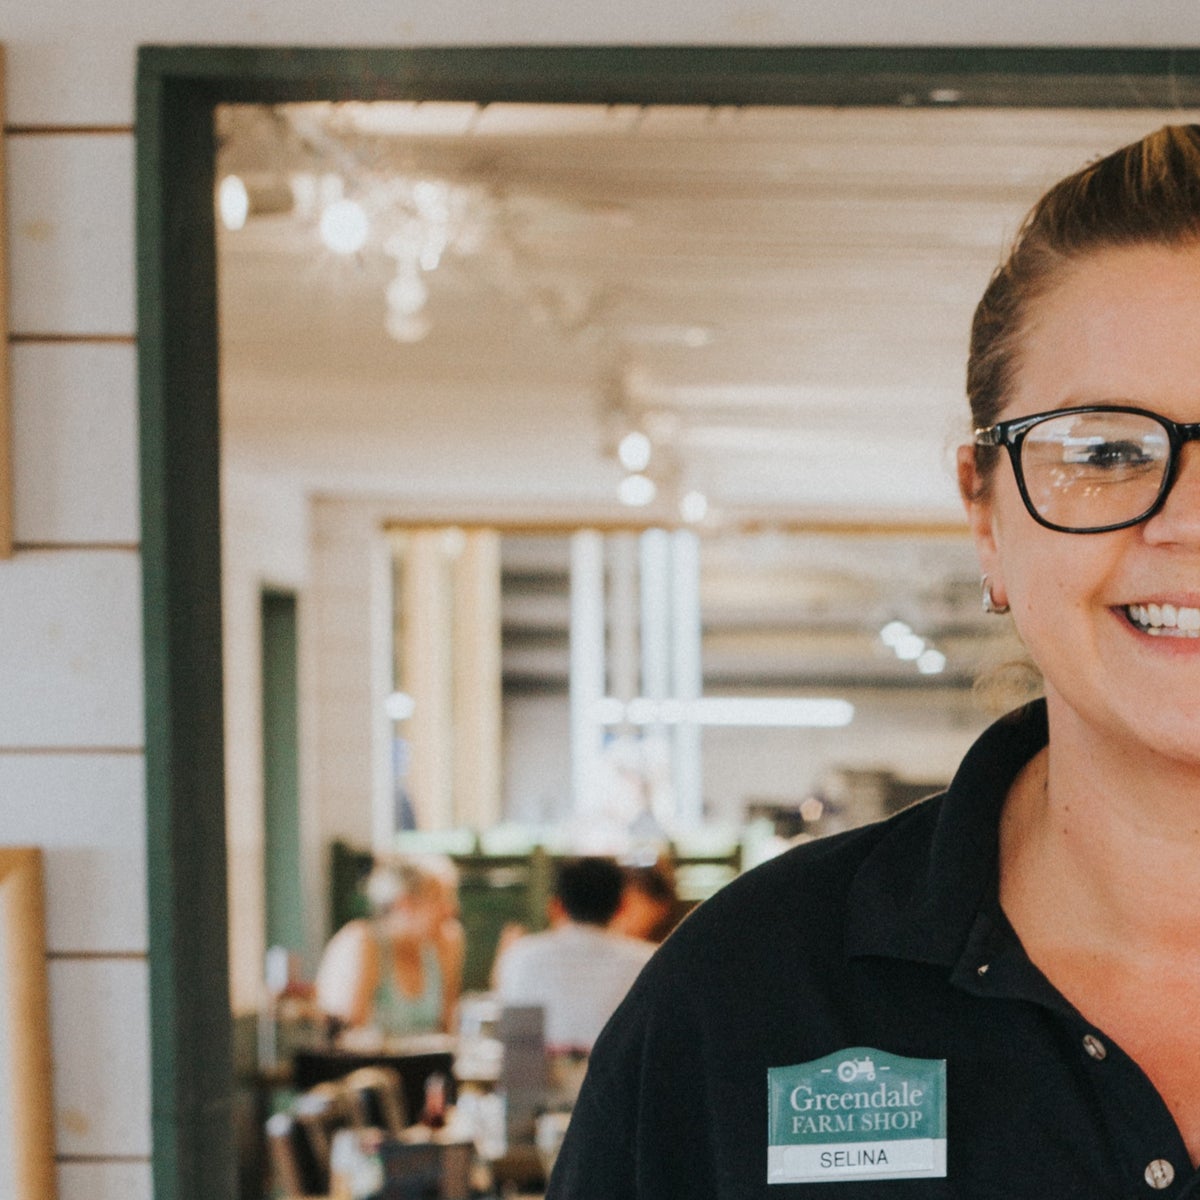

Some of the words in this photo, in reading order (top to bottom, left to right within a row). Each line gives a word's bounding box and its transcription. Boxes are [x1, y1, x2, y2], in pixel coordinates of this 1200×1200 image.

[790, 1081, 923, 1111] Greendale
[791, 1114, 854, 1134] FARM
[861, 1111, 923, 1131] SHOP
[820, 1149, 889, 1168] SELINA
